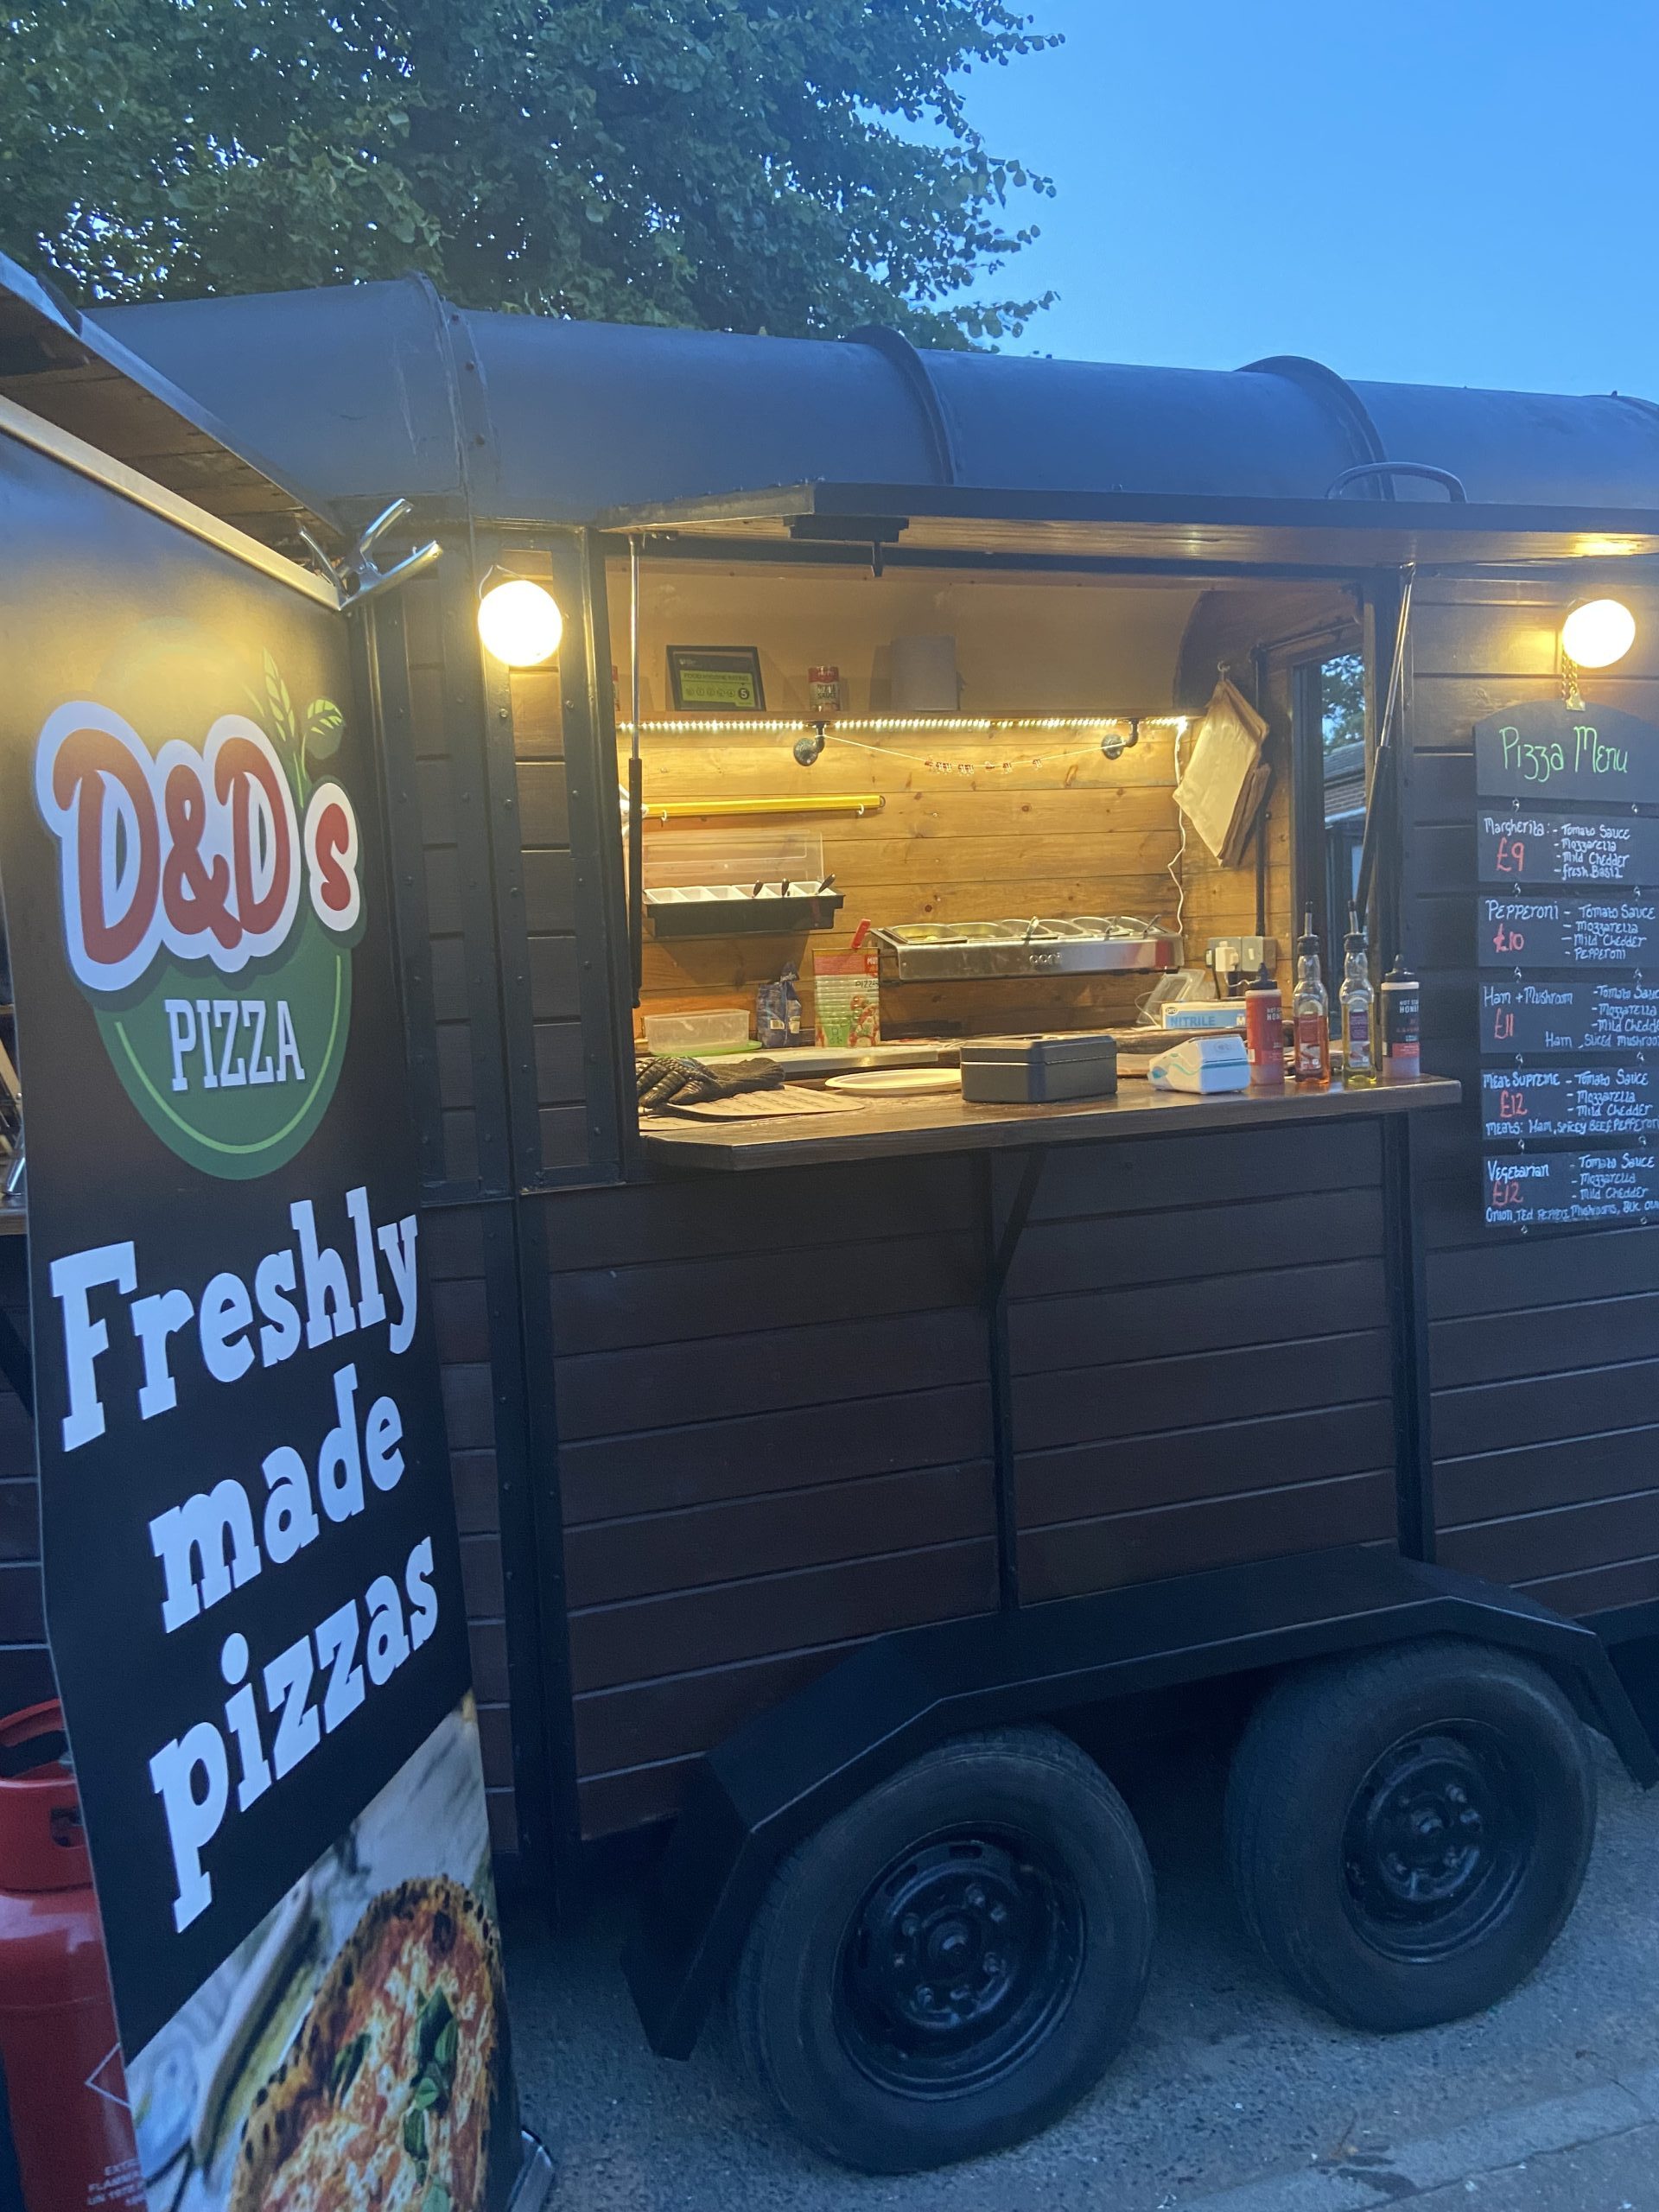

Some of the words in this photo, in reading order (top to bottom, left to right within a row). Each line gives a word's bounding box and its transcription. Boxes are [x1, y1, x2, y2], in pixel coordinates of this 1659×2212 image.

[741, 690, 748, 699] 5
[1499, 726, 1564, 783] Pizza
[1560, 823, 1596, 836] Tomato
[1599, 824, 1630, 840] Sauce
[1496, 836, 1525, 872] £9
[1562, 851, 1583, 863] Mild
[1578, 904, 1618, 918] Tomato
[1621, 904, 1656, 919] Sauce
[1493, 923, 1524, 953] £10
[1574, 933, 1598, 946] Mild
[1483, 986, 1511, 1007] Ham
[1596, 985, 1631, 1000] Tomato
[1633, 984, 1659, 1000] Sauc
[1170, 1015, 1216, 1027] NITRILE
[1494, 1007, 1514, 1039] £11
[1597, 1019, 1622, 1033] Mild
[164, 999, 306, 1092] PIZZA
[1617, 1035, 1659, 1047] Mushroo
[1574, 1071, 1611, 1086] Tomato
[1616, 1068, 1649, 1085] Sauce
[1500, 1090, 1528, 1118] £12
[1576, 1105, 1601, 1116] Mild
[1613, 1117, 1659, 1131] Pepperon
[1578, 1154, 1617, 1169] Tomato
[1621, 1152, 1655, 1169] Sauce
[1492, 1180, 1523, 1206] £12
[1580, 1187, 1601, 1200] Mild
[50, 1186, 420, 1452] Freshly
[150, 1363, 405, 1635] made
[149, 1535, 439, 1935] pizzas
